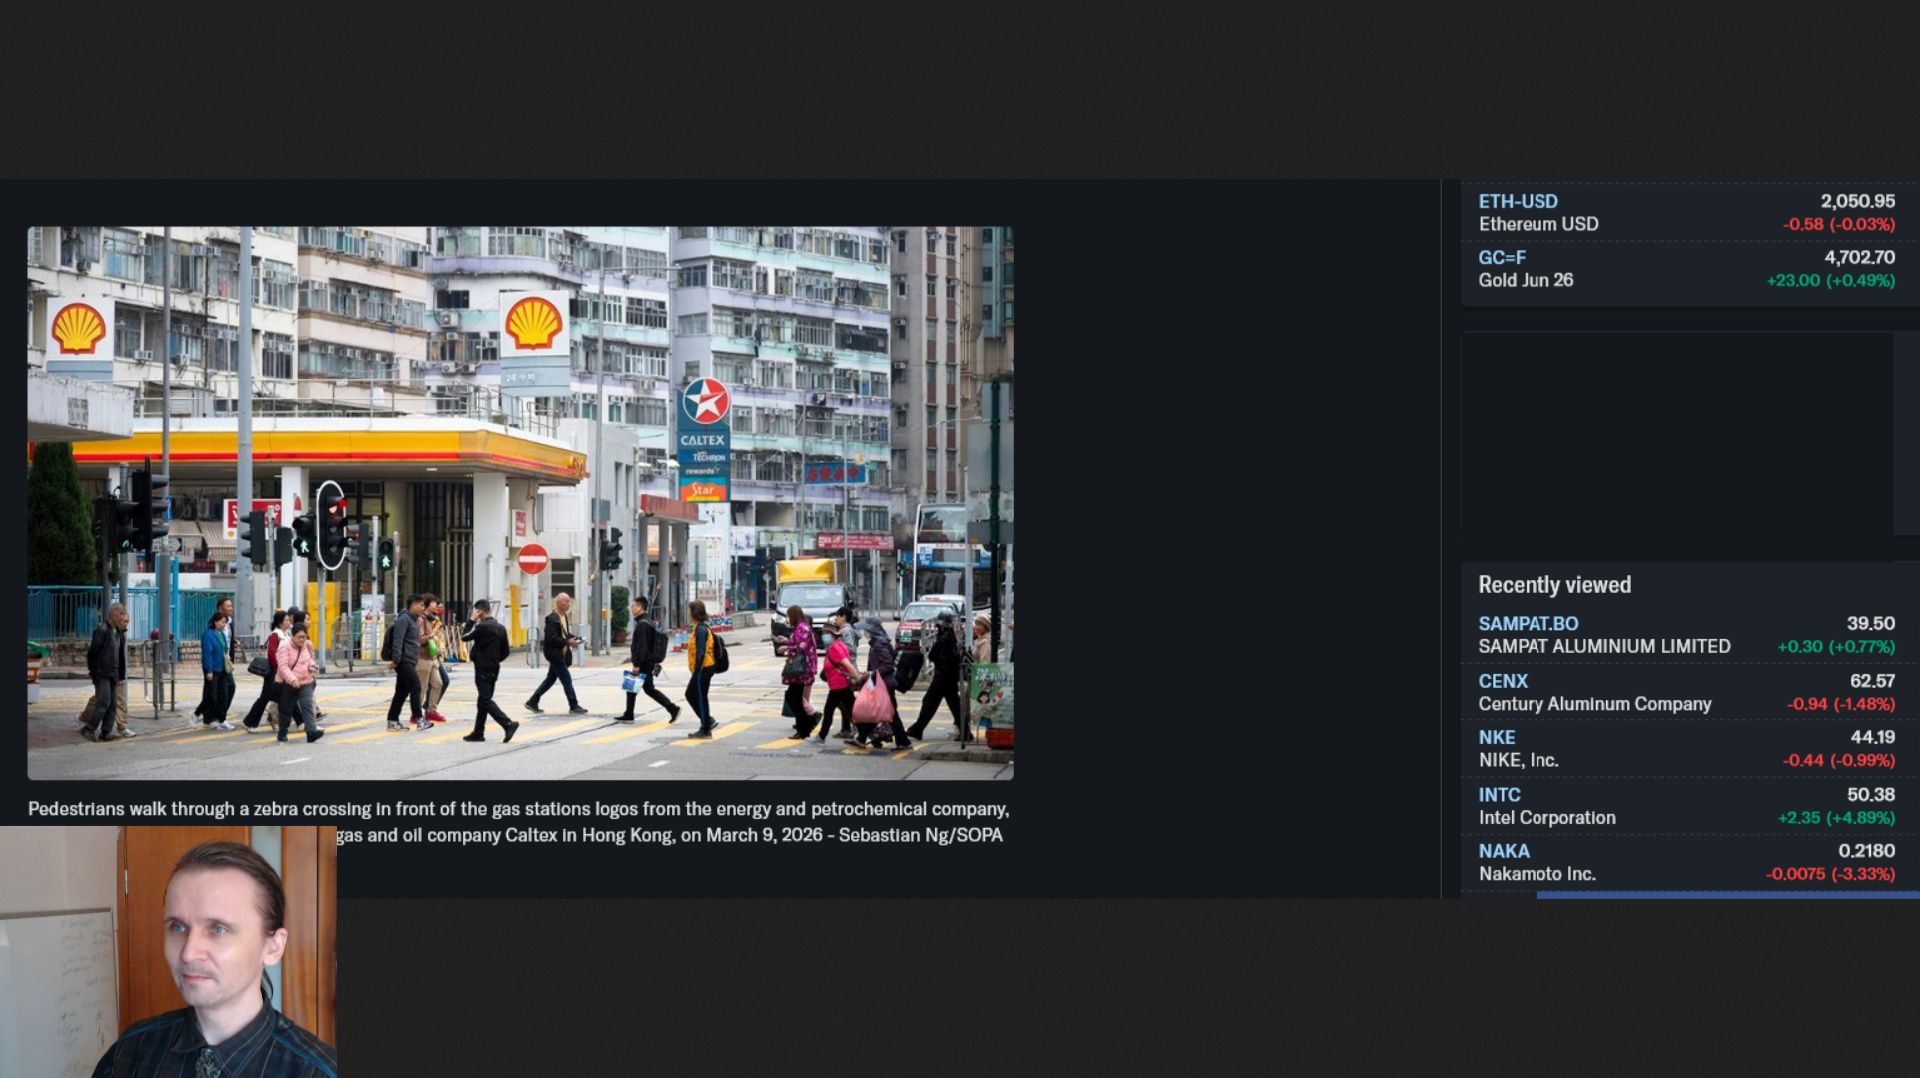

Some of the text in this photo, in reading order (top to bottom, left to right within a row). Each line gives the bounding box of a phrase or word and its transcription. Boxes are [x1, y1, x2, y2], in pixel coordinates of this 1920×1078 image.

[1479, 193, 1559, 209] ETH-USD
[1820, 193, 1896, 212] 2,050.95
[1479, 215, 1600, 232] Ethereum USD
[1783, 216, 1896, 234] -0.58 (-0.03%)
[1478, 249, 1527, 265] GC=F
[1824, 249, 1896, 268] 4,702.70
[1478, 271, 1574, 288] Gold Jun 26
[1767, 273, 1896, 290] +23.00 (+0.49%)
[680, 434, 725, 446] CALTEX
[692, 482, 714, 497] Star
[1479, 574, 1632, 599] Recently viewed
[1478, 615, 1580, 632] SAMPAT.BO
[1846, 615, 1896, 632] 39.50
[1478, 638, 1732, 654] SAMPAT ALUMINIUM LIMITED
[1778, 639, 1896, 656] +0.30 (+0.77%)
[1478, 673, 1529, 689] CENX
[1850, 673, 1896, 689] 62.57
[1478, 695, 1713, 715] Century Aluminum Company
[1786, 696, 1896, 714] -0.94 (-1.48%)
[1479, 729, 1516, 745] NKE
[1850, 729, 1896, 745] 44.19
[1479, 751, 1560, 770] NIKE, Inc.
[1783, 753, 1896, 770] -0.44 (-0.99%)
[1479, 786, 1522, 803] INTC
[1847, 786, 1896, 803] 50.38
[28, 800, 1010, 820] Pedestrians walk through a zebra crossing in front of the gas stations logos from the energy and petrochemical company,
[1778, 810, 1896, 827] +2.35 (+4.89%)
[1479, 809, 1617, 829] Intel Corporation
[337, 829, 364, 847] gas
[367, 827, 398, 843] and
[402, 826, 423, 843] oil
[427, 830, 502, 846] company
[505, 826, 558, 843] Caltex
[562, 828, 577, 843] in
[582, 826, 627, 846] Hong
[630, 826, 677, 847] Kong,
[680, 830, 702, 843] on
[706, 826, 759, 843] March
[762, 826, 778, 845] 9,
[781, 826, 824, 843] 2026
[839, 826, 921, 843] Sebastian
[925, 826, 1004, 847] Ng/SOPA
[1478, 842, 1531, 859] NAKA
[1838, 843, 1896, 859] 0.2180
[1479, 865, 1597, 882] Nakamoto Inc.
[1765, 866, 1896, 884] -0.0075 (-3.33%)
